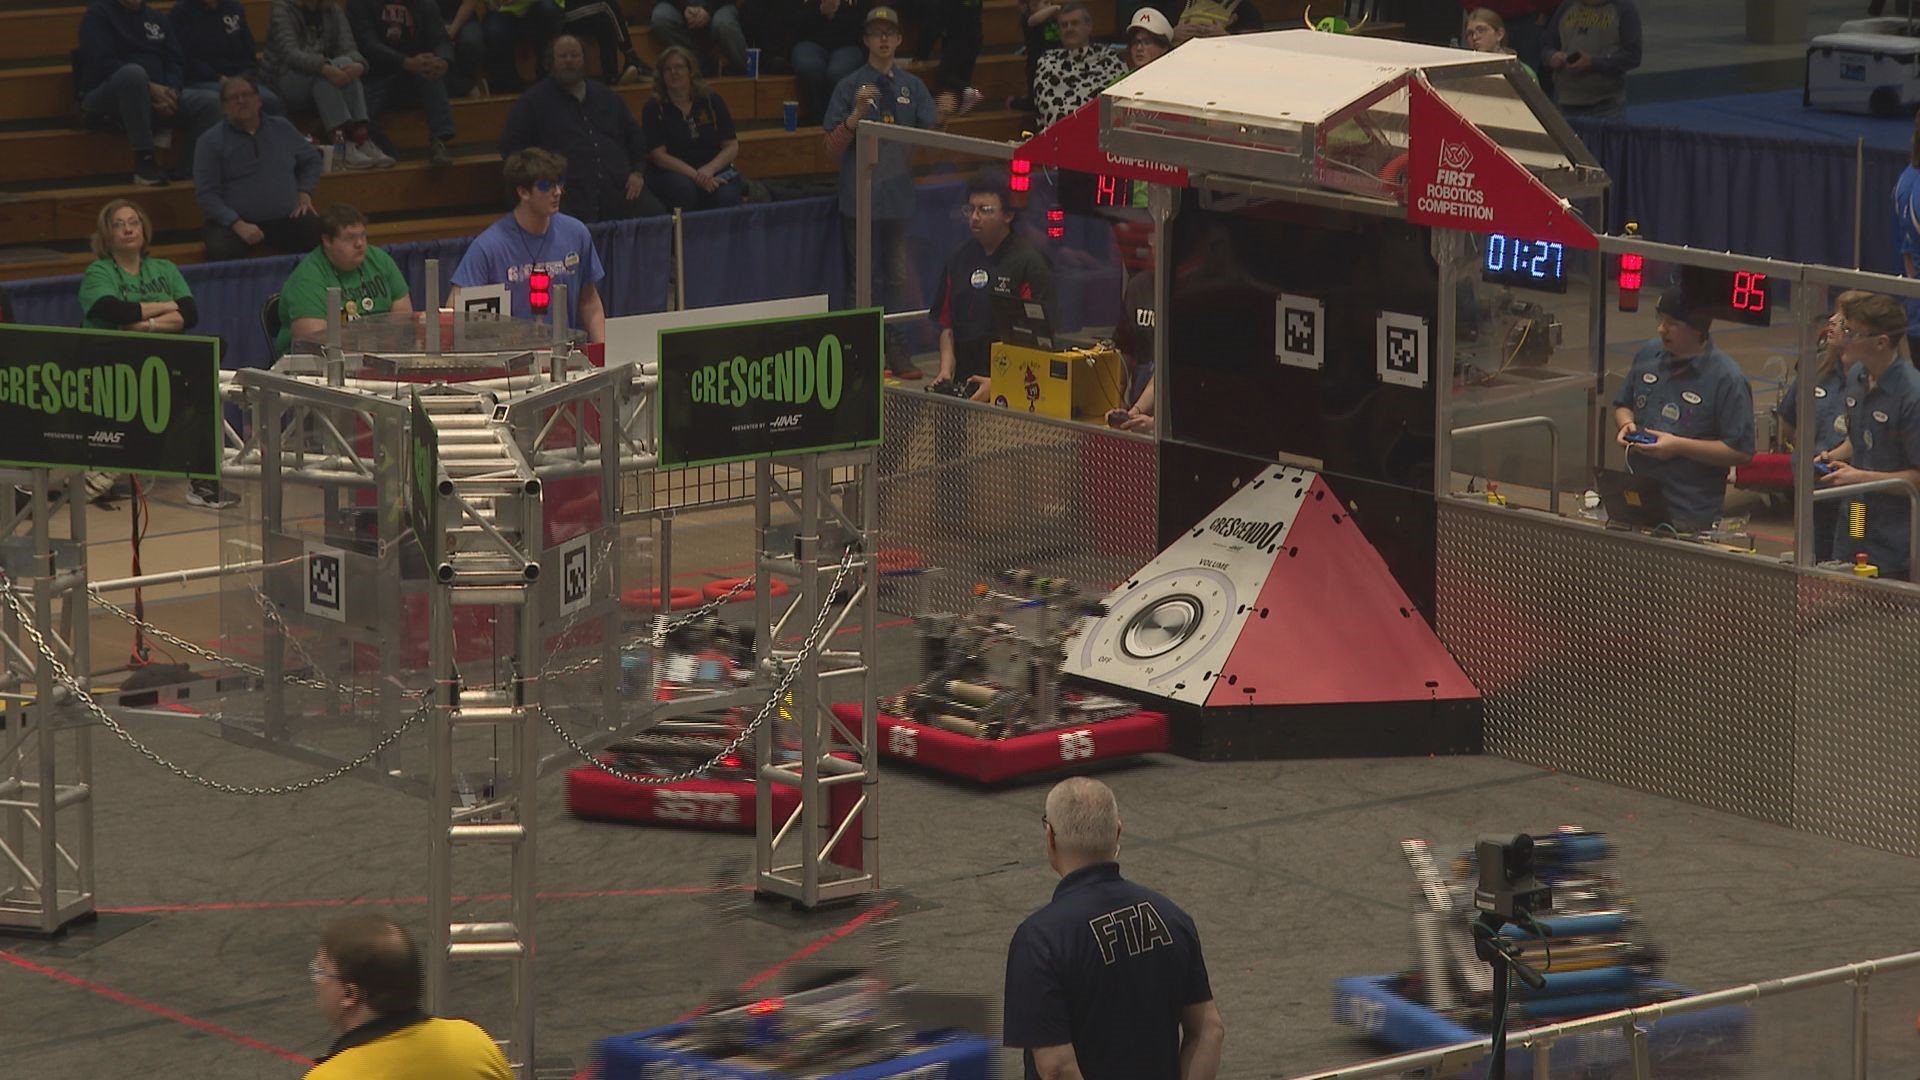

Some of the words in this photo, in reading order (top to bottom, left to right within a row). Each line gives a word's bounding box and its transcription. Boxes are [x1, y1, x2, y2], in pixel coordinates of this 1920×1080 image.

[1140, 14, 1151, 22] M
[1427, 183, 1484, 204] ROBOTICS
[1436, 169, 1476, 188] FIRST
[1417, 197, 1494, 221] COMPETITION
[1488, 233, 1563, 278] 01:27
[1733, 271, 1767, 311] 85
[691, 333, 844, 410] CRESCENDO
[0, 356, 171, 434] CRESCENDO
[769, 414, 803, 428] HAAS
[88, 431, 126, 443] HAAS
[1210, 517, 1284, 550] CRESCENDO
[1199, 558, 1231, 571] VOLUME
[1098, 655, 1113, 664] OFF
[888, 724, 919, 757] 85
[1058, 730, 1095, 761] 85
[654, 788, 742, 823] 3572
[1088, 901, 1174, 965] FTA
